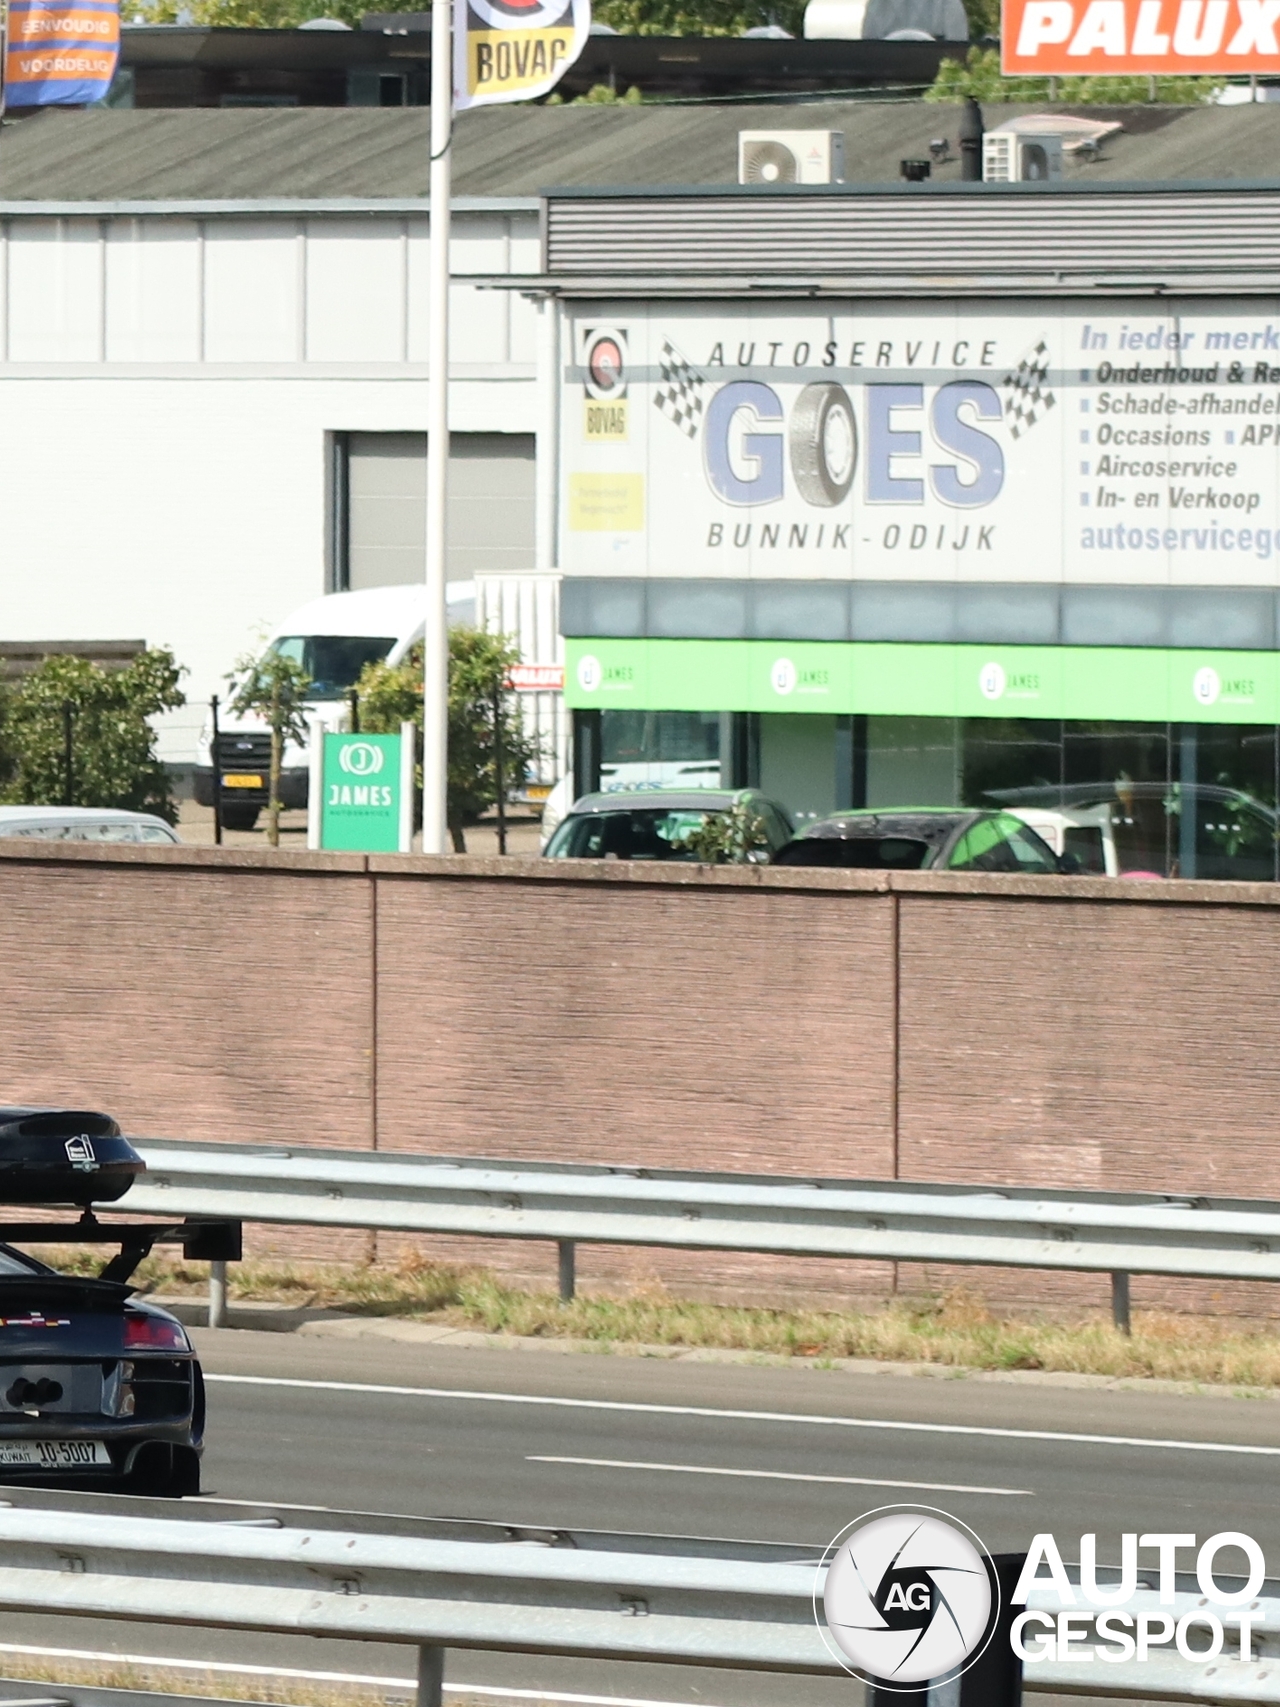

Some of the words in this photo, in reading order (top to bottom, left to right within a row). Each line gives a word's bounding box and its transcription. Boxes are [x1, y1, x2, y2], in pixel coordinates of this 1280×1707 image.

[22, 18, 110, 34] EENVOUDIG
[1015, 0, 1280, 56] PALUX
[21, 58, 109, 73] VOORDELIG
[1081, 325, 1108, 350] In
[1119, 324, 1195, 350] ieder
[1205, 324, 1280, 350] merk
[707, 341, 997, 367] AUTOSERVICE
[1096, 361, 1219, 384] Onderhoud
[1226, 361, 1245, 384] &
[587, 407, 625, 434] BOVAG
[1097, 423, 1211, 446] Occasions
[1096, 454, 1238, 477] Aircoservice
[1096, 485, 1126, 508] In-
[1134, 490, 1160, 508] en
[1169, 486, 1261, 514] Verkoop
[328, 784, 392, 806] JAMES
[0, 1452, 32, 1463] KUWAIT
[36, 1441, 97, 1463] 10-5007
